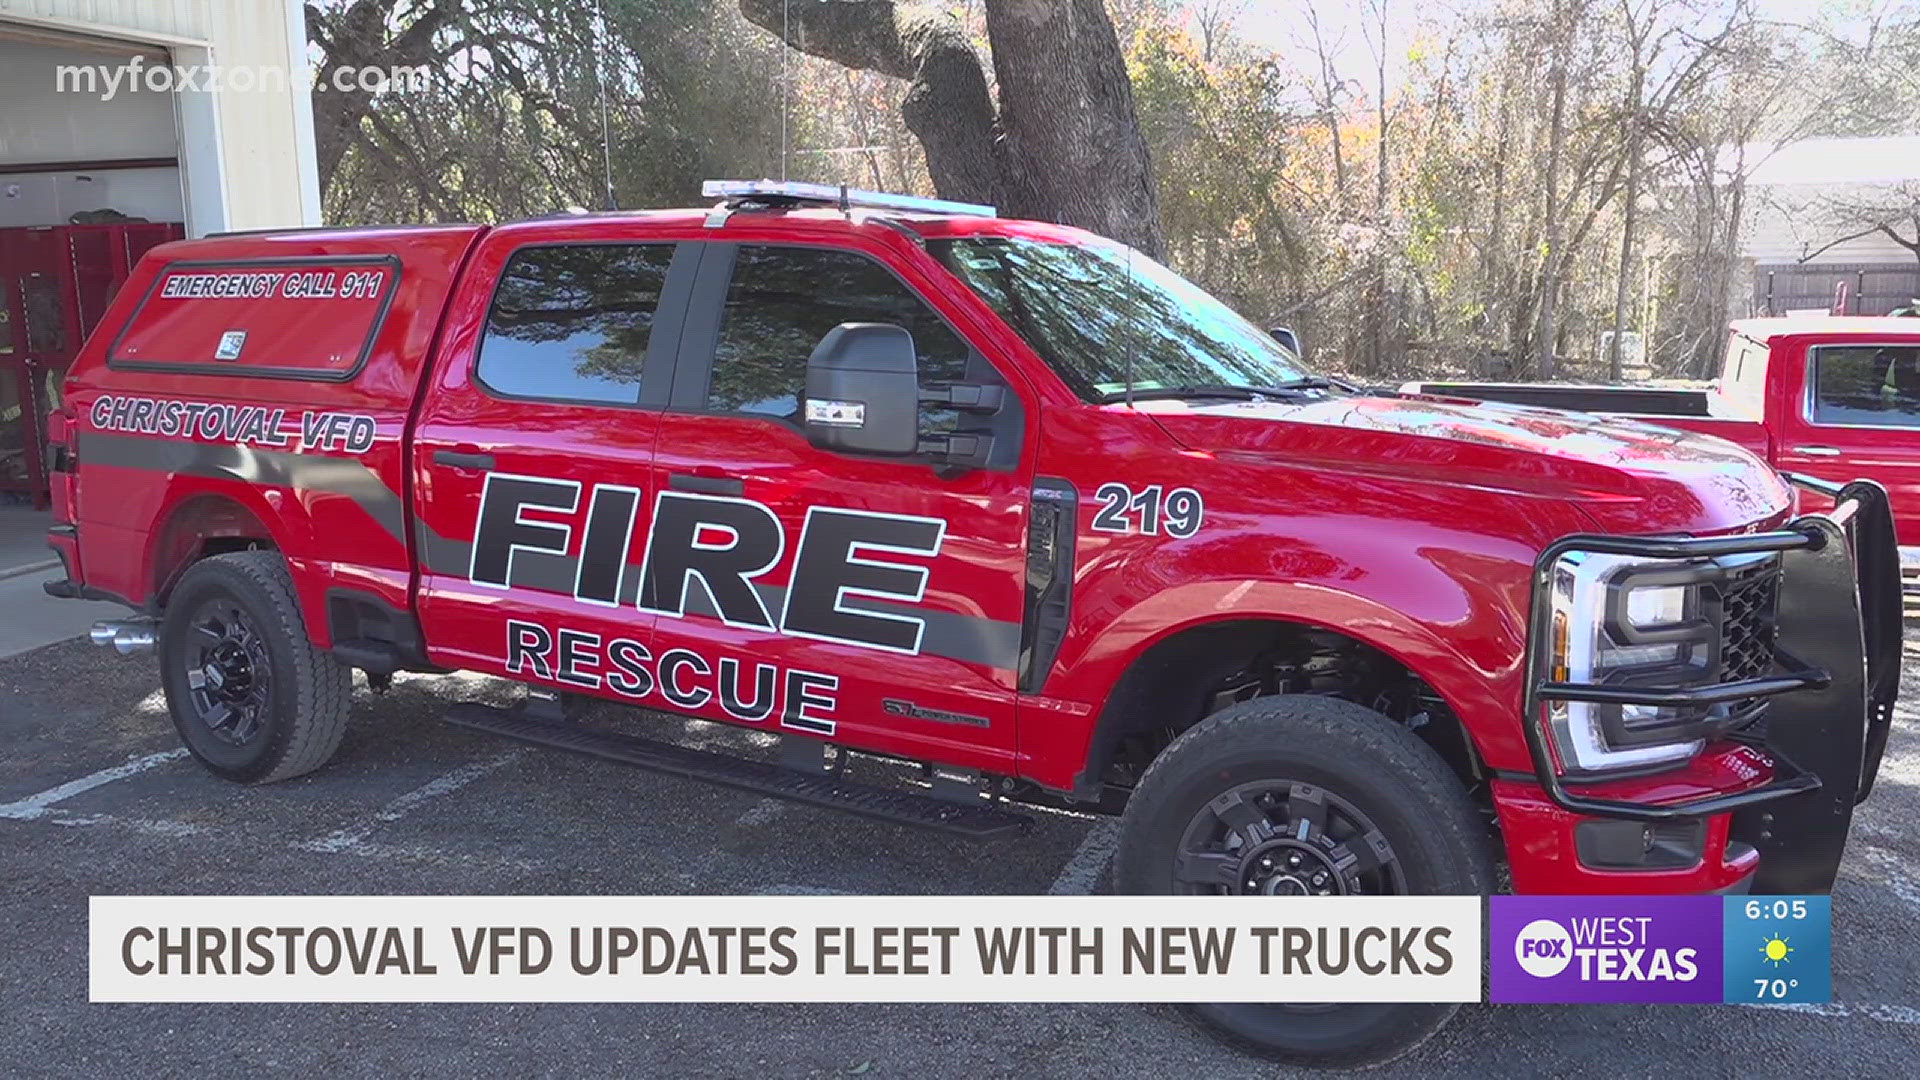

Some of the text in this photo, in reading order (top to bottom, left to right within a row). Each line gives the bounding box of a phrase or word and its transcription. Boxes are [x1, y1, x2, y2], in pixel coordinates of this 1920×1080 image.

[161, 272, 384, 298] EMERGENCY CALL 911
[91, 395, 376, 453] CHRISTOVAL VFD
[1091, 482, 1203, 539] 219
[469, 472, 946, 656] FIRE
[506, 618, 839, 736] RESCUE
